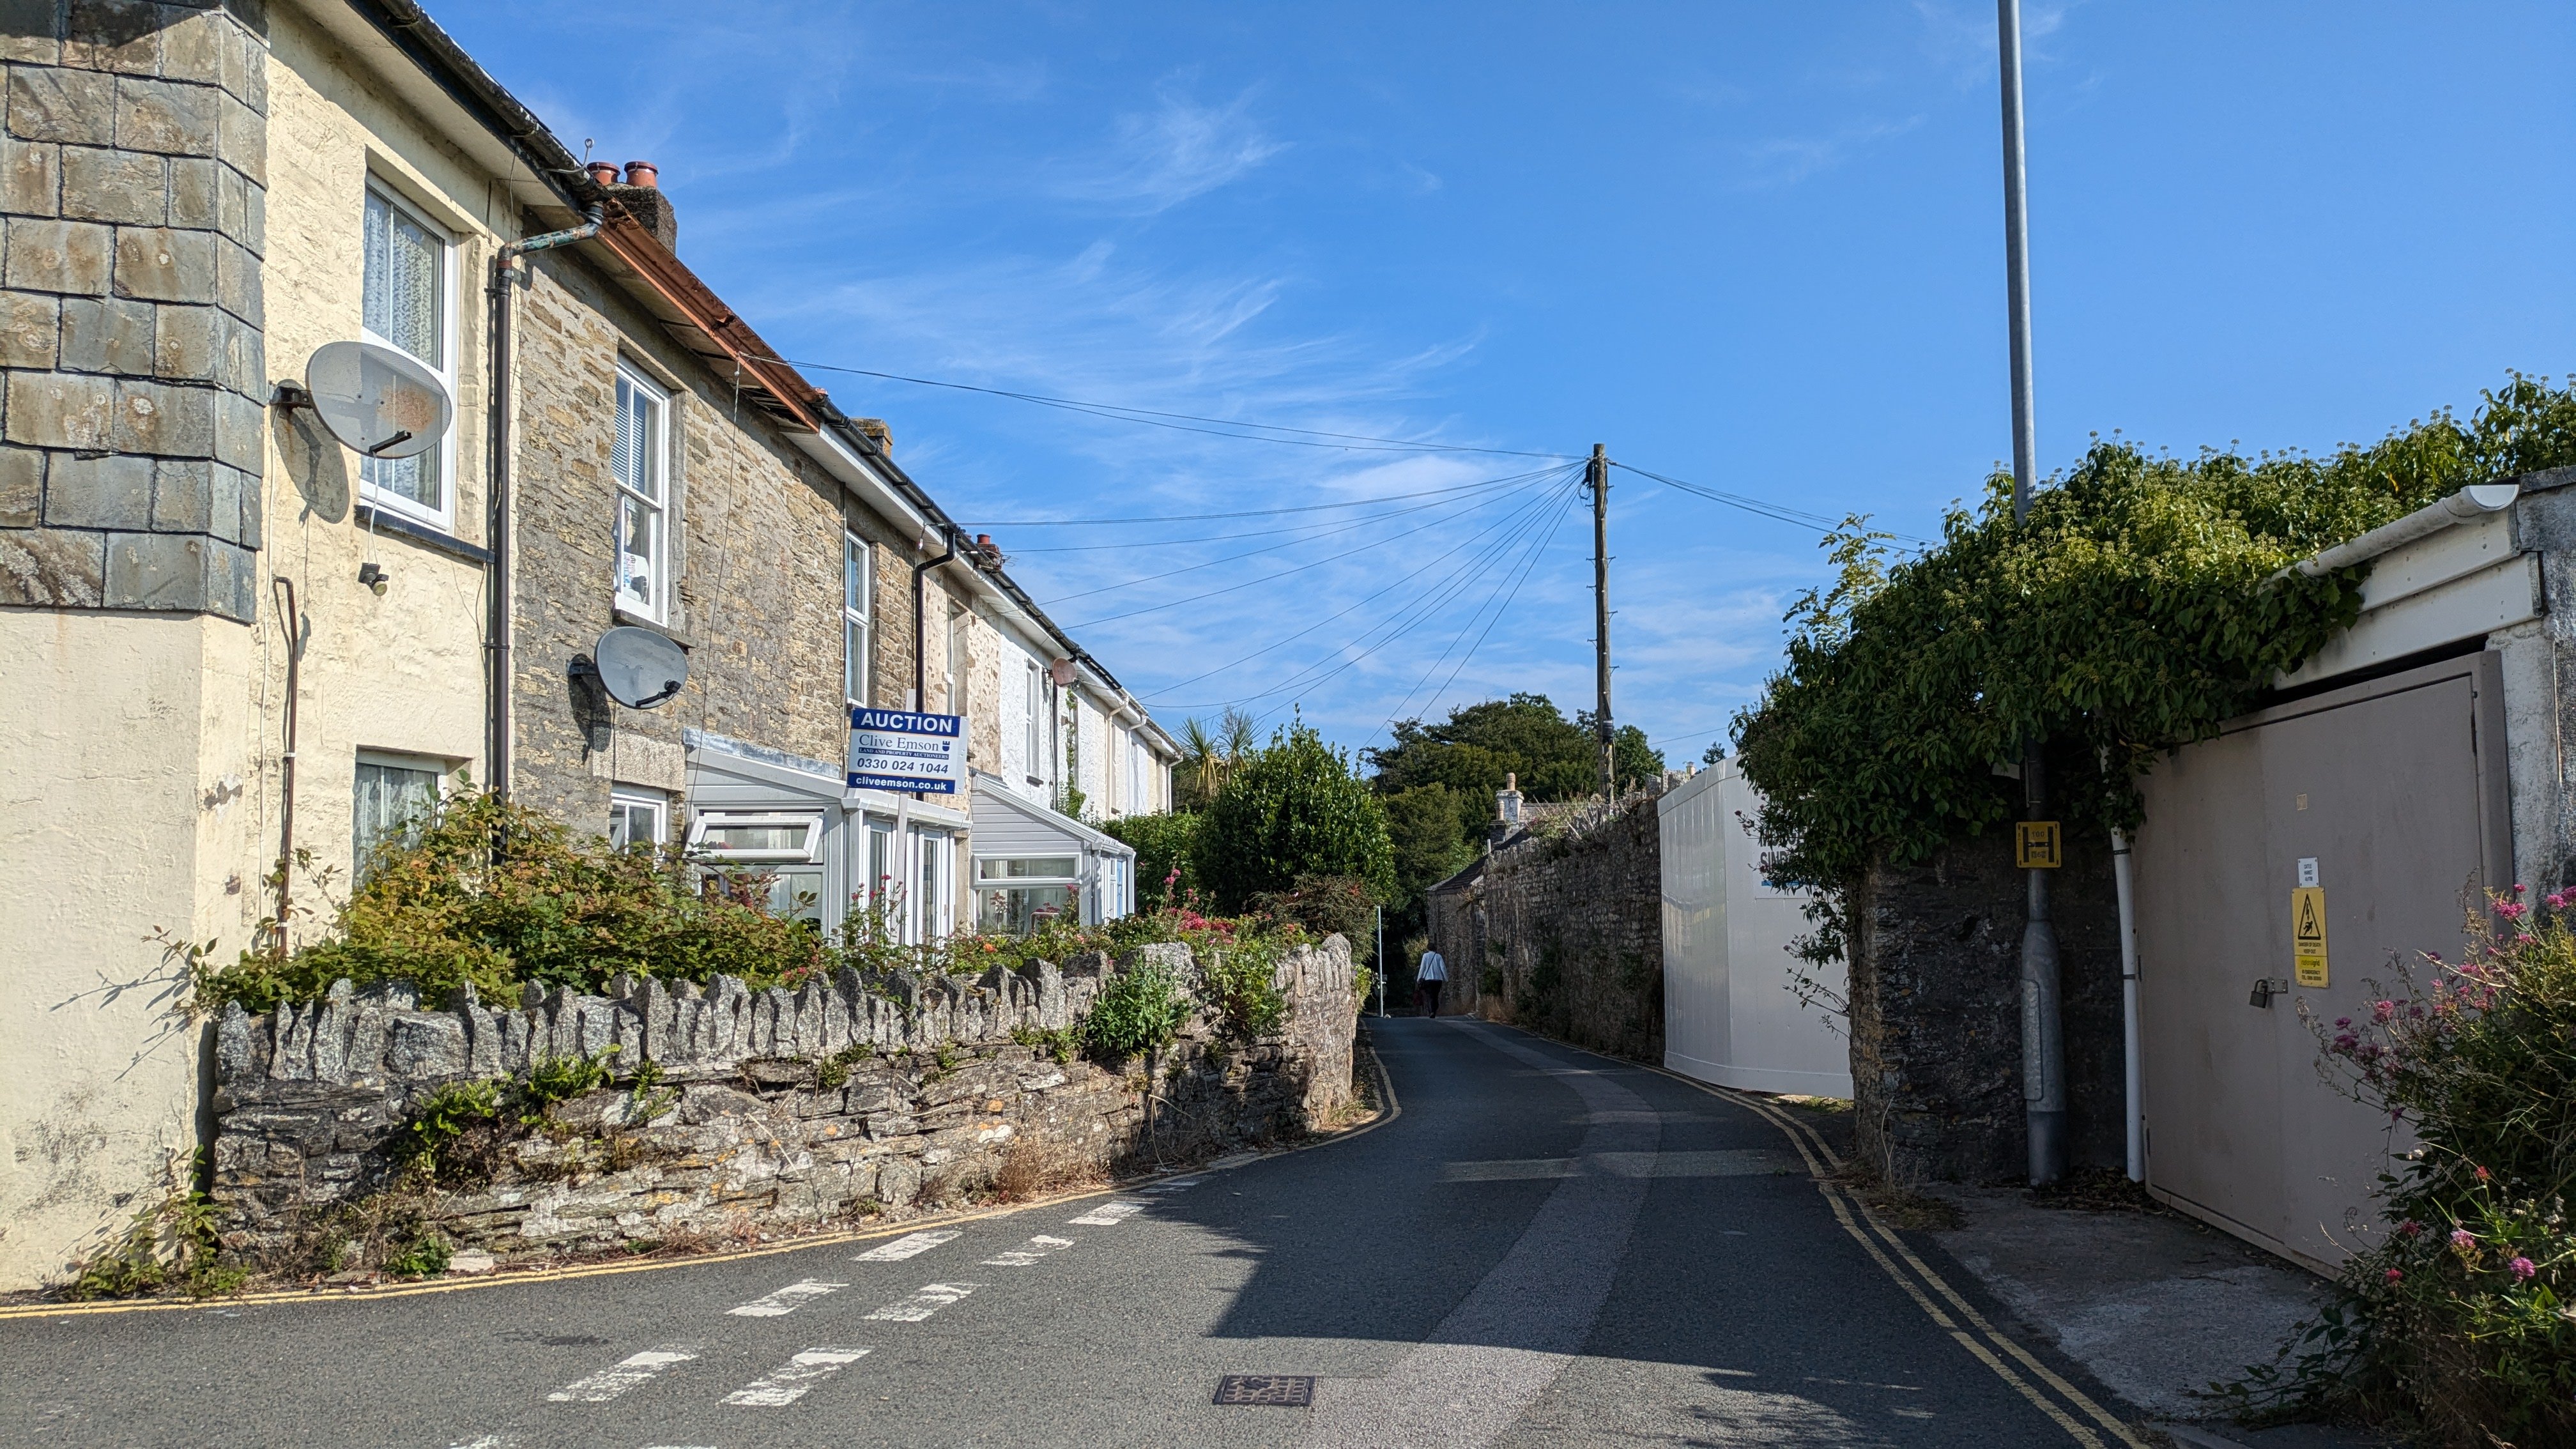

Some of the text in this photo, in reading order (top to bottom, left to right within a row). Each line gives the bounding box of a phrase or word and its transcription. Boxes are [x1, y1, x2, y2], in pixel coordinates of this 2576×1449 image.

[861, 712, 952, 733] AUCTION
[859, 735, 939, 751] Clive Emson
[857, 758, 949, 774] 0330 024 1044
[856, 776, 946, 790] cliveemson.co.uk
